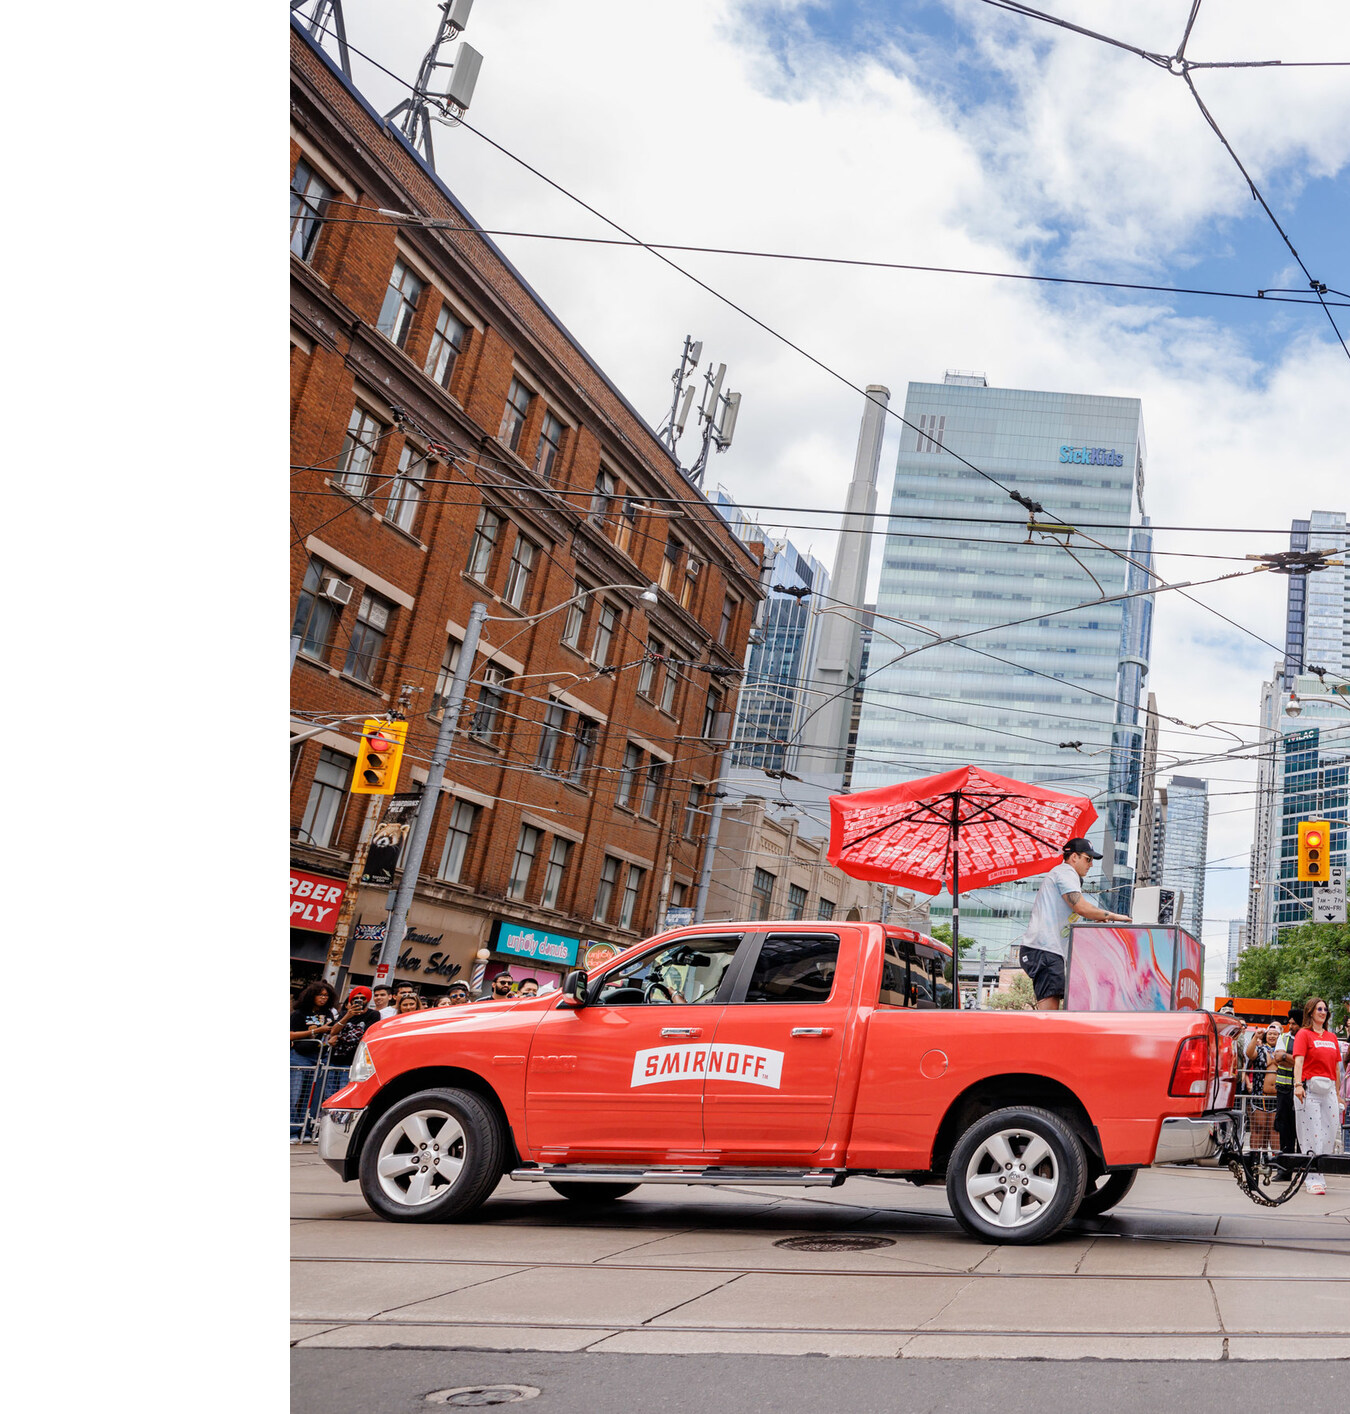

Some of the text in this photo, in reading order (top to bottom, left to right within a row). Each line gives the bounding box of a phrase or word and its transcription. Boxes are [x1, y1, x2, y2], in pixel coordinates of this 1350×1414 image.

[1060, 445, 1123, 467] SickKids
[507, 930, 568, 959] unholy donuts
[424, 952, 462, 982] Shop
[645, 1050, 767, 1078] SMIRNOFF
